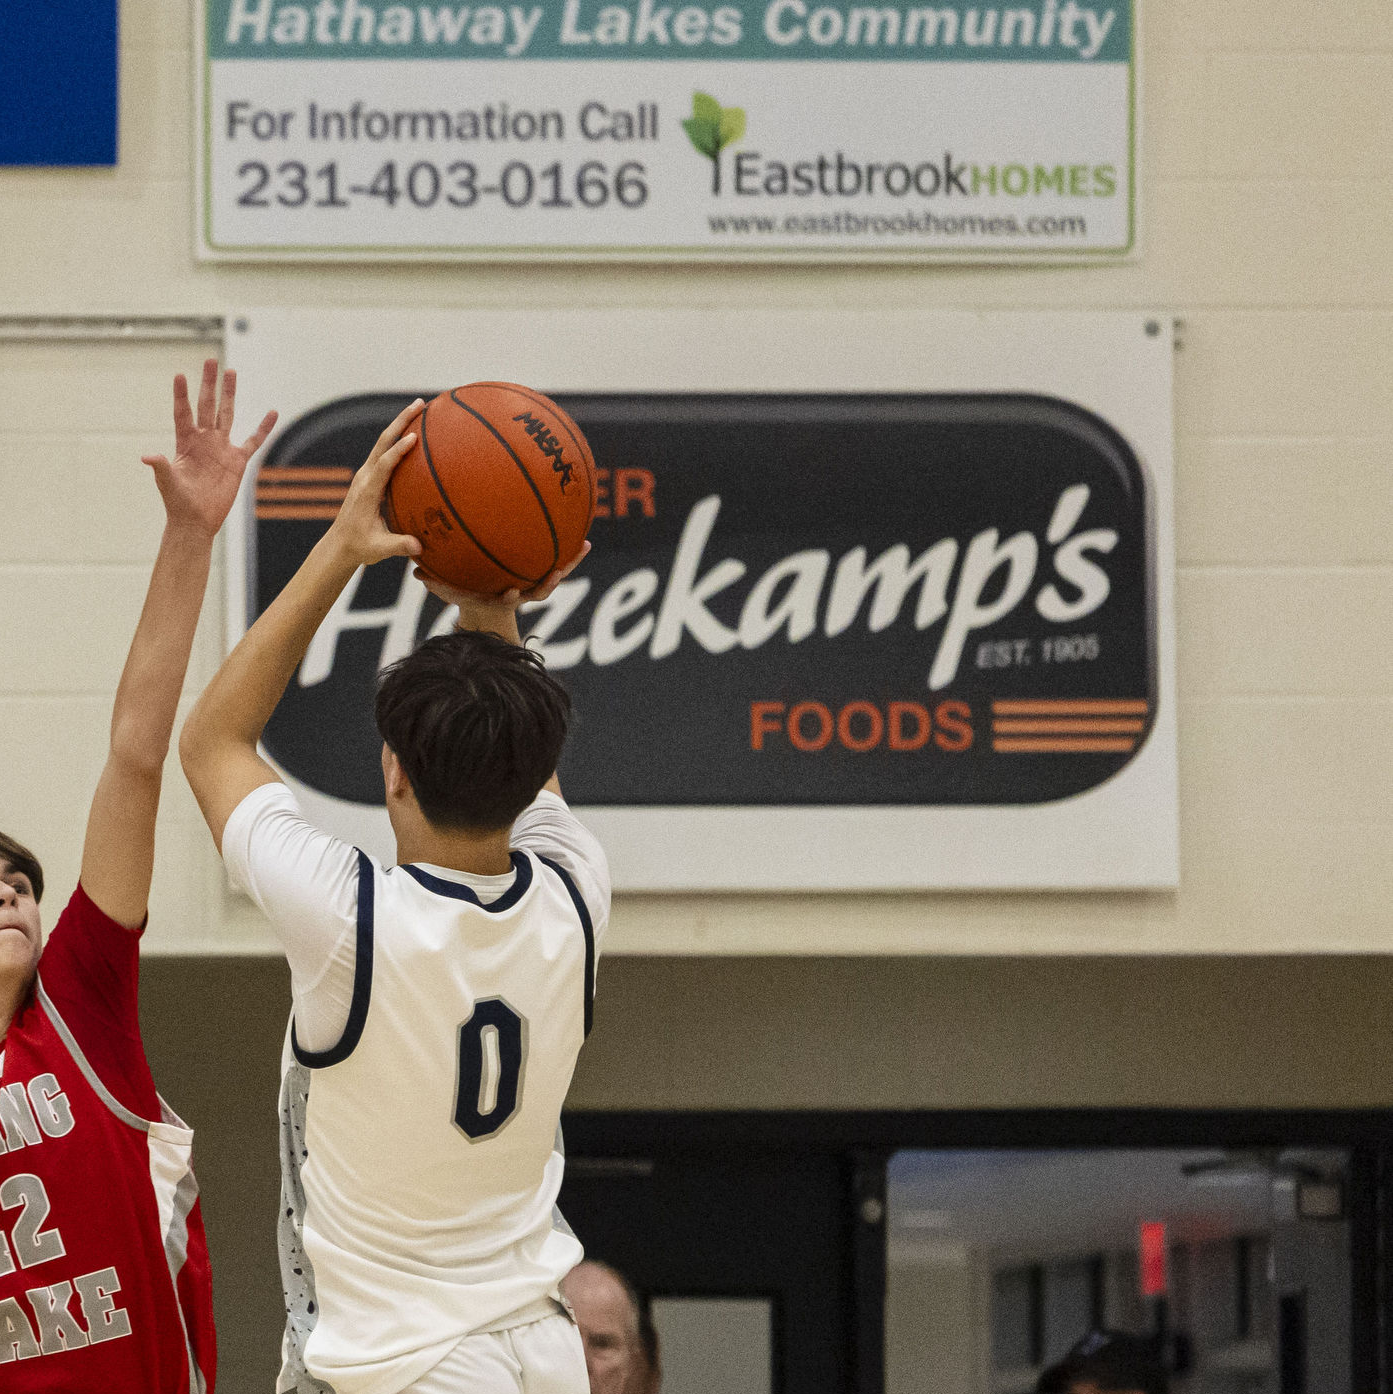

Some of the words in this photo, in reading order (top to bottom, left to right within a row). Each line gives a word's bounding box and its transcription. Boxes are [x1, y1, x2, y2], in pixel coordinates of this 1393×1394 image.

[225, 0, 542, 57] Hathaway
[559, 0, 743, 46] Lakes
[763, 0, 1117, 59] Community
[226, 101, 294, 141] For
[307, 101, 565, 141] Information
[579, 101, 660, 141] Call
[236, 160, 650, 209] 231-403-0166
[708, 211, 1087, 237] www.eastbrookhomes.com
[298, 483, 1119, 692] Hzekamp's
[975, 638, 1032, 670] EST.
[1041, 633, 1101, 664] 1905
[750, 701, 975, 752] FOODS
[450, 994, 530, 1144] 0
